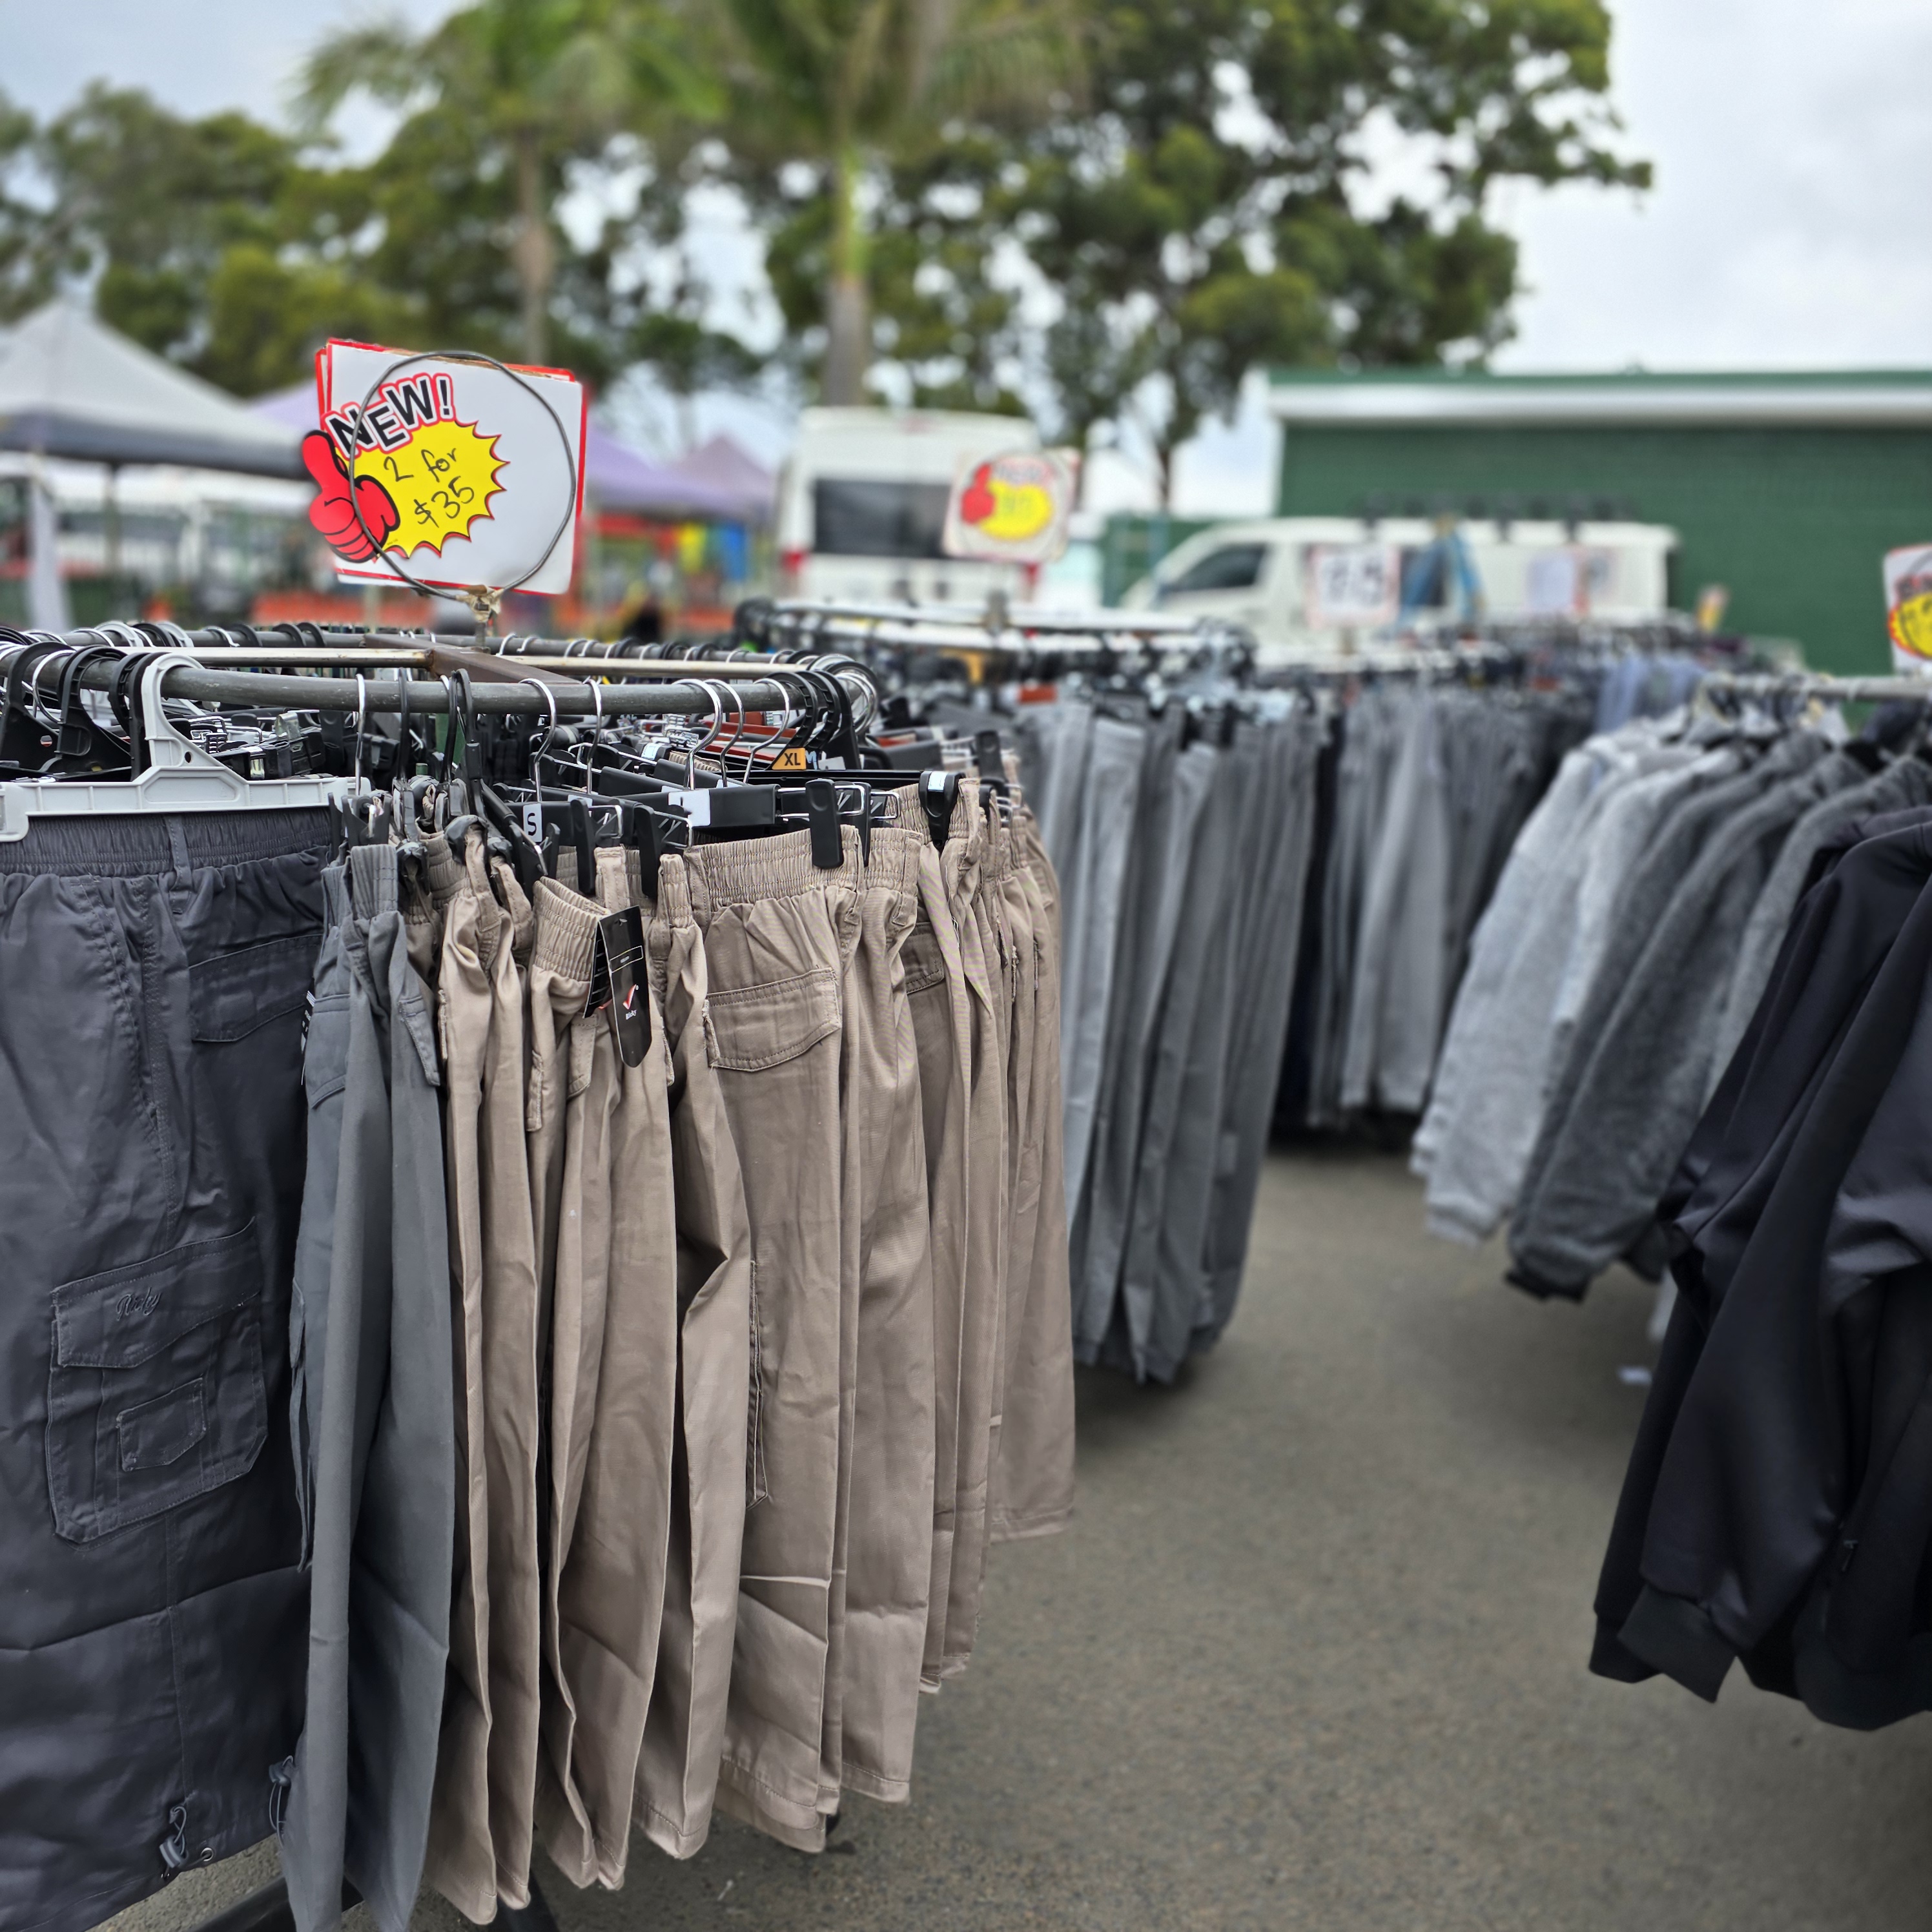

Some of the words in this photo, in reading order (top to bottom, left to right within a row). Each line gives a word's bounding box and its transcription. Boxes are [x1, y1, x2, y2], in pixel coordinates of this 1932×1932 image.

[328, 378, 451, 455] NEW!
[383, 455, 415, 482] 2
[420, 447, 457, 483] for
[413, 475, 475, 528] $35
[784, 752, 801, 766] XL
[527, 812, 537, 836] S
